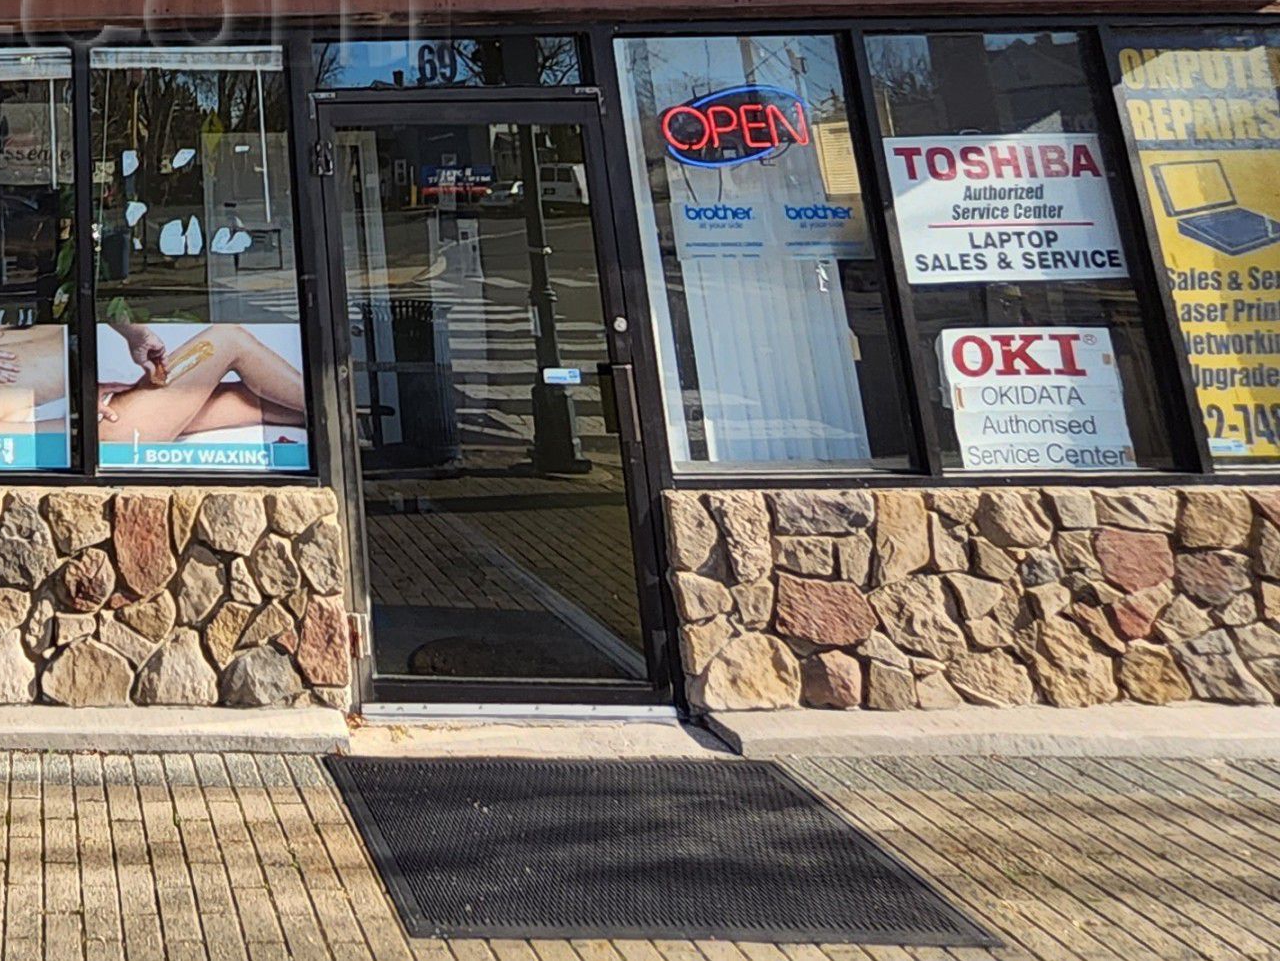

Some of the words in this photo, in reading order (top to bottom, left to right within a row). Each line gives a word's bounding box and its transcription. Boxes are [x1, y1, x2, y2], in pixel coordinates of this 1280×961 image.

[417, 43, 458, 84] 69
[661, 100, 810, 151] OPEN
[1126, 98, 1280, 141] REPAIRS
[892, 144, 1103, 181] TOSHIBA
[963, 184, 1045, 201] Authorized
[684, 204, 753, 220] brother
[784, 204, 852, 220] brother
[952, 205, 1010, 221] Service
[1013, 203, 1064, 220] Center
[968, 230, 1059, 249] LAPTOP
[915, 252, 988, 272] SALES
[997, 252, 1014, 270] &
[1021, 249, 1122, 271] SERVICE
[1227, 269, 1243, 290] &
[1180, 302, 1228, 322] aser
[951, 333, 1088, 378] OKI
[981, 385, 1086, 406] OKIDATA
[982, 415, 1098, 435] Authorised
[145, 449, 194, 463] BODY
[197, 449, 269, 465] WAXING
[967, 444, 1040, 467] Service
[1046, 443, 1127, 466] Center
